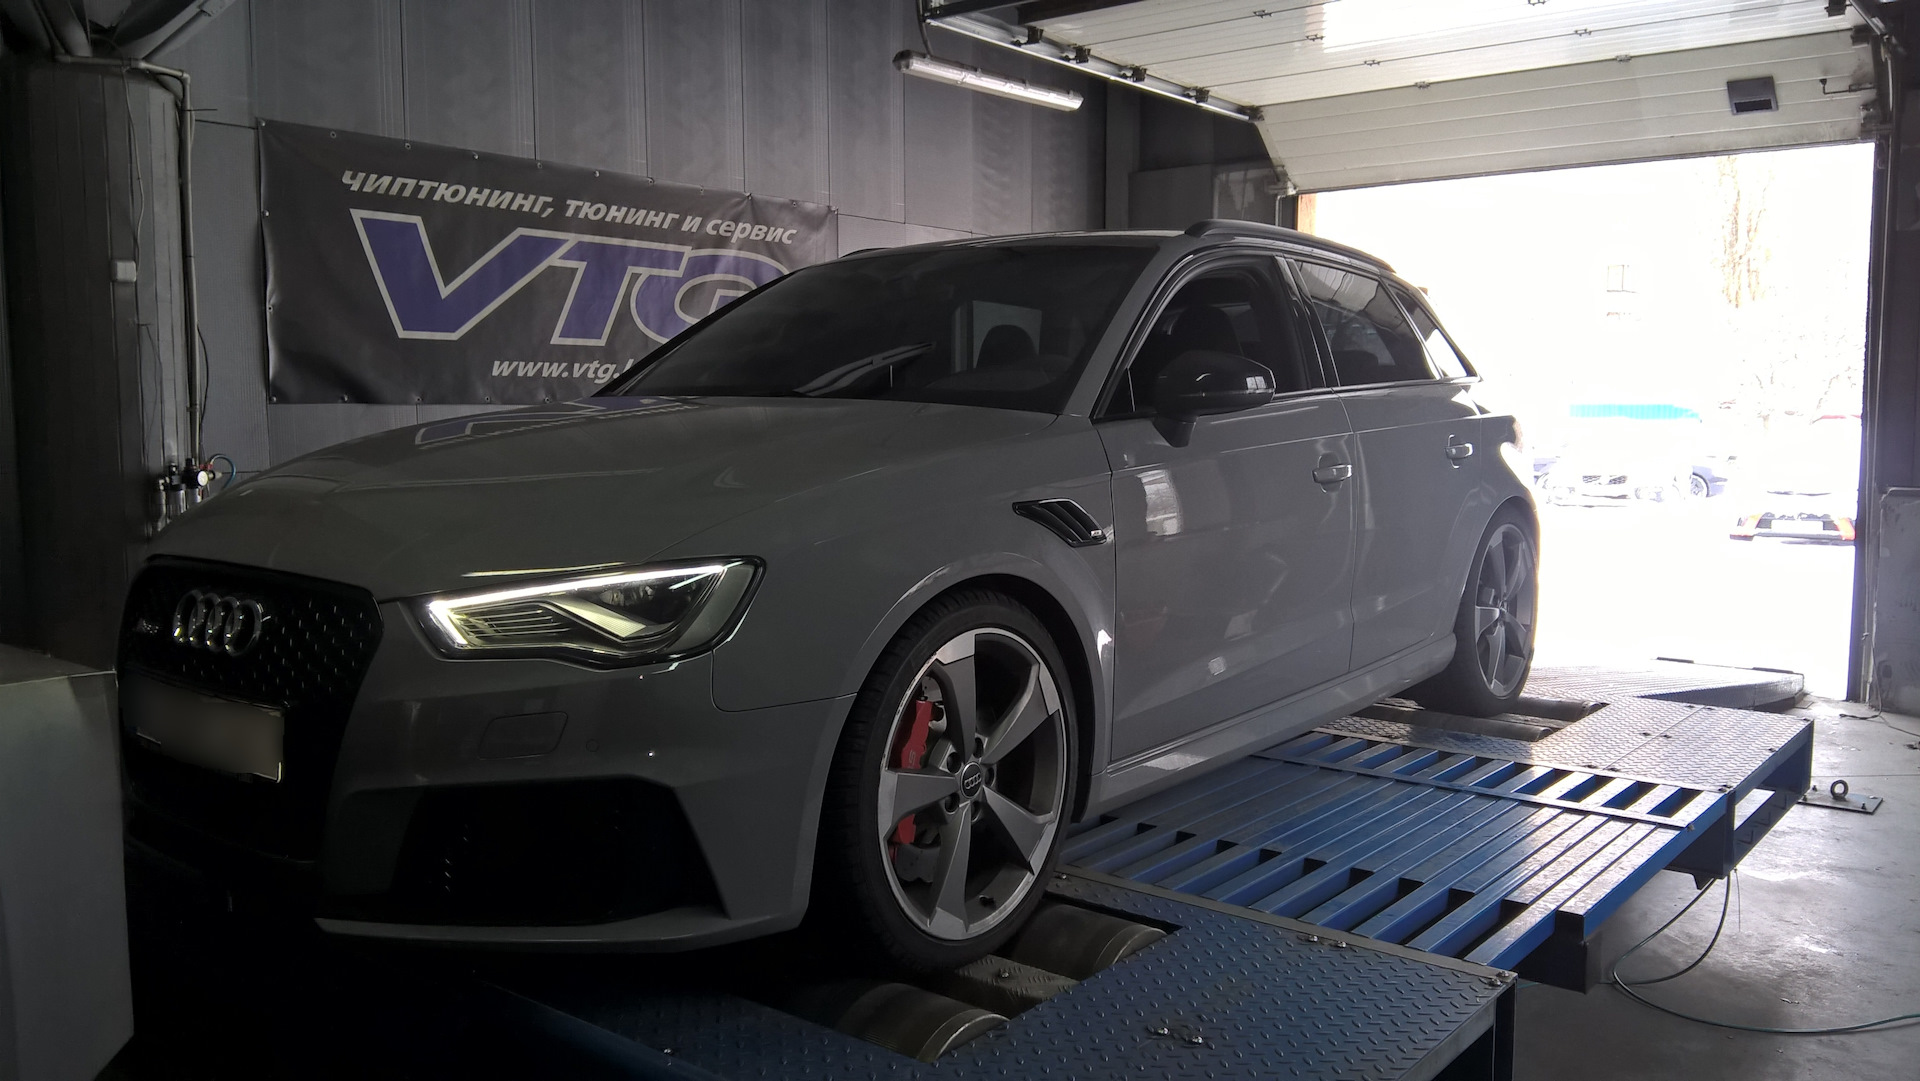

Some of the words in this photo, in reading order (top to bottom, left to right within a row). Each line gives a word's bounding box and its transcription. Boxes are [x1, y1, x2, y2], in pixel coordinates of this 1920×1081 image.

[341, 169, 554, 218] чиптюнинг,
[565, 199, 680, 230] тюнинг
[680, 215, 703, 233] и
[706, 218, 798, 245] сервис
